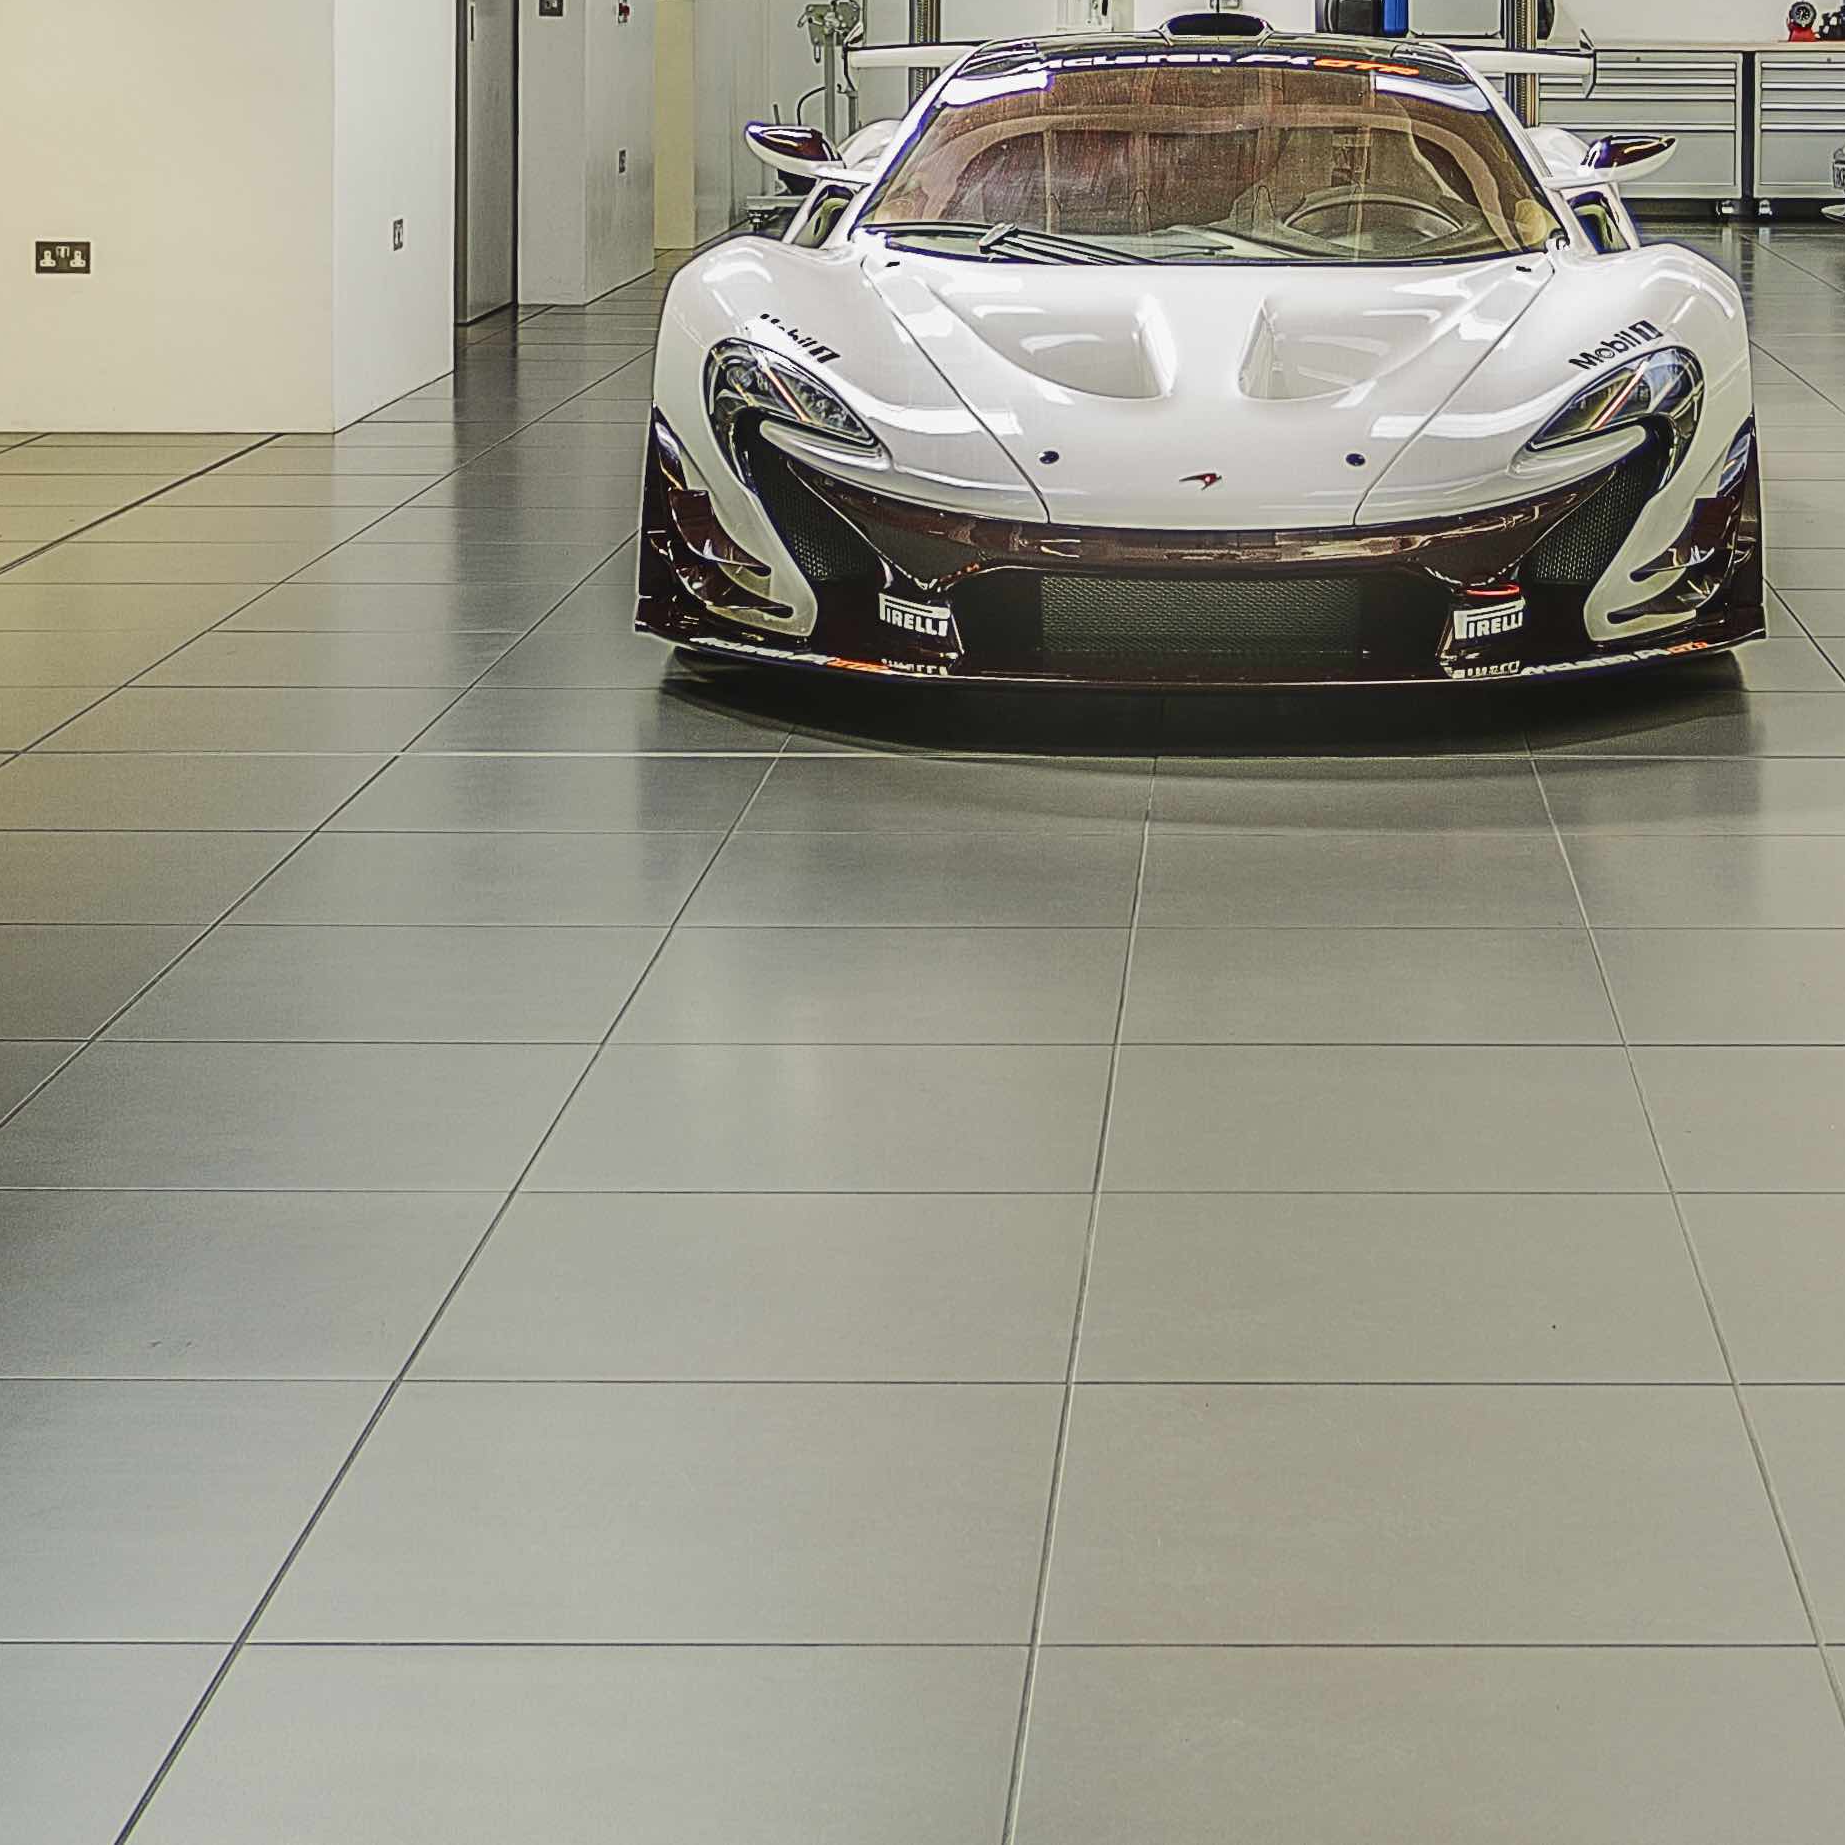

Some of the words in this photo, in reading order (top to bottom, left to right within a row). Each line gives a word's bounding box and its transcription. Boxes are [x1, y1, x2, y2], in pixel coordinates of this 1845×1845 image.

[1568, 330, 1642, 370] Mobil
[1628, 319, 1664, 342] 1
[878, 592, 952, 638] PIRELLI
[1453, 595, 1527, 640] PIRELLI
